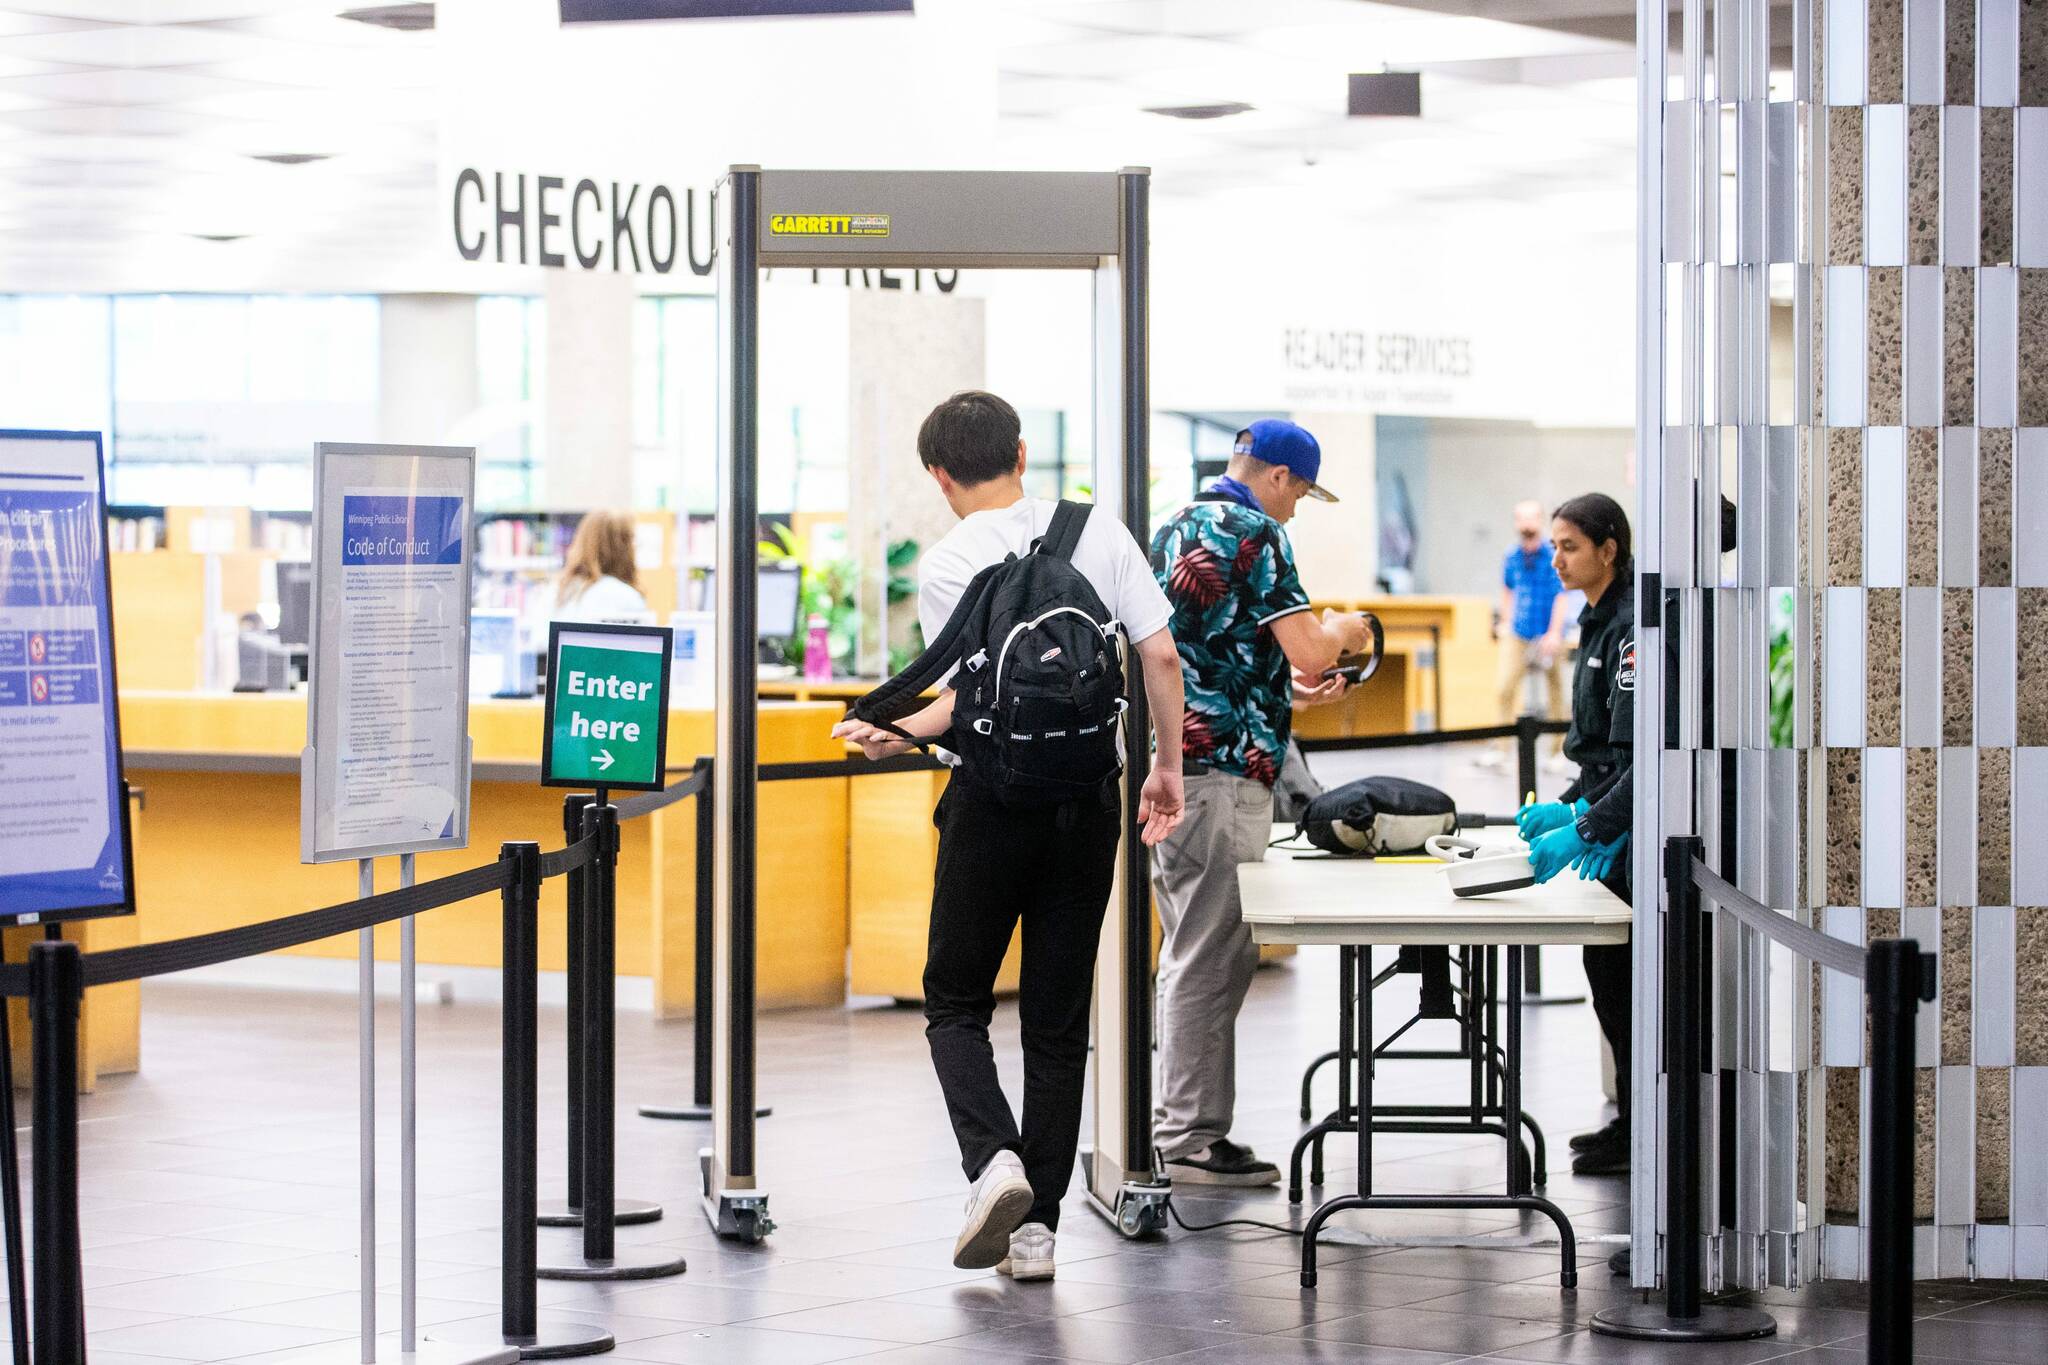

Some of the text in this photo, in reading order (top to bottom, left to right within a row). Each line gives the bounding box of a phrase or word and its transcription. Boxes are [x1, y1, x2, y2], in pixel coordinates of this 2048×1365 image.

[454, 167, 717, 276] CHECKOU
[772, 216, 851, 234] GARRETT
[1284, 327, 1472, 377] READER SERVICES
[348, 513, 374, 527] Winnipeg
[374, 513, 391, 525] Public
[347, 537, 430, 556] Code of Conduct
[568, 671, 653, 701] Enter
[570, 711, 641, 742] here
